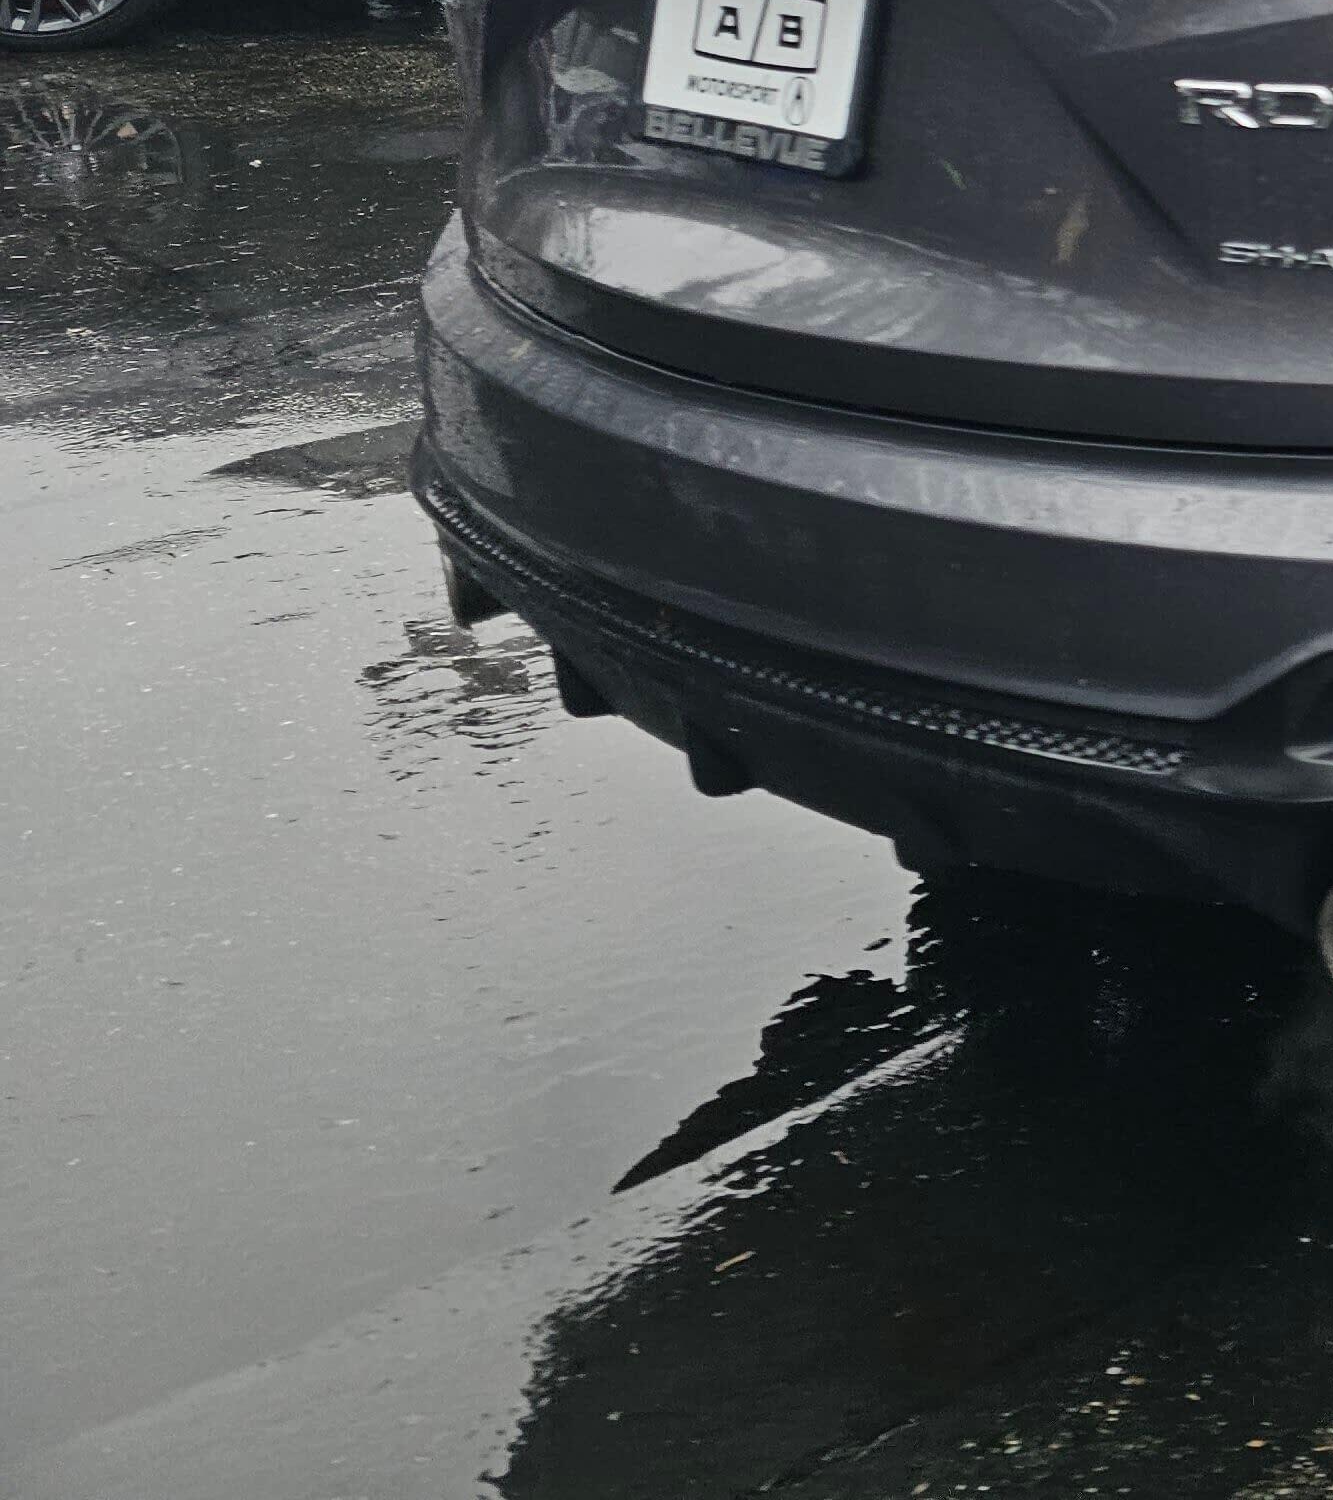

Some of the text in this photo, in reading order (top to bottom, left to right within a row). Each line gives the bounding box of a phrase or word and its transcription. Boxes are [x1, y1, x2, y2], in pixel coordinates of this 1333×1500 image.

[713, 5, 804, 49] A B
[645, 111, 830, 171] BELLEVUE
